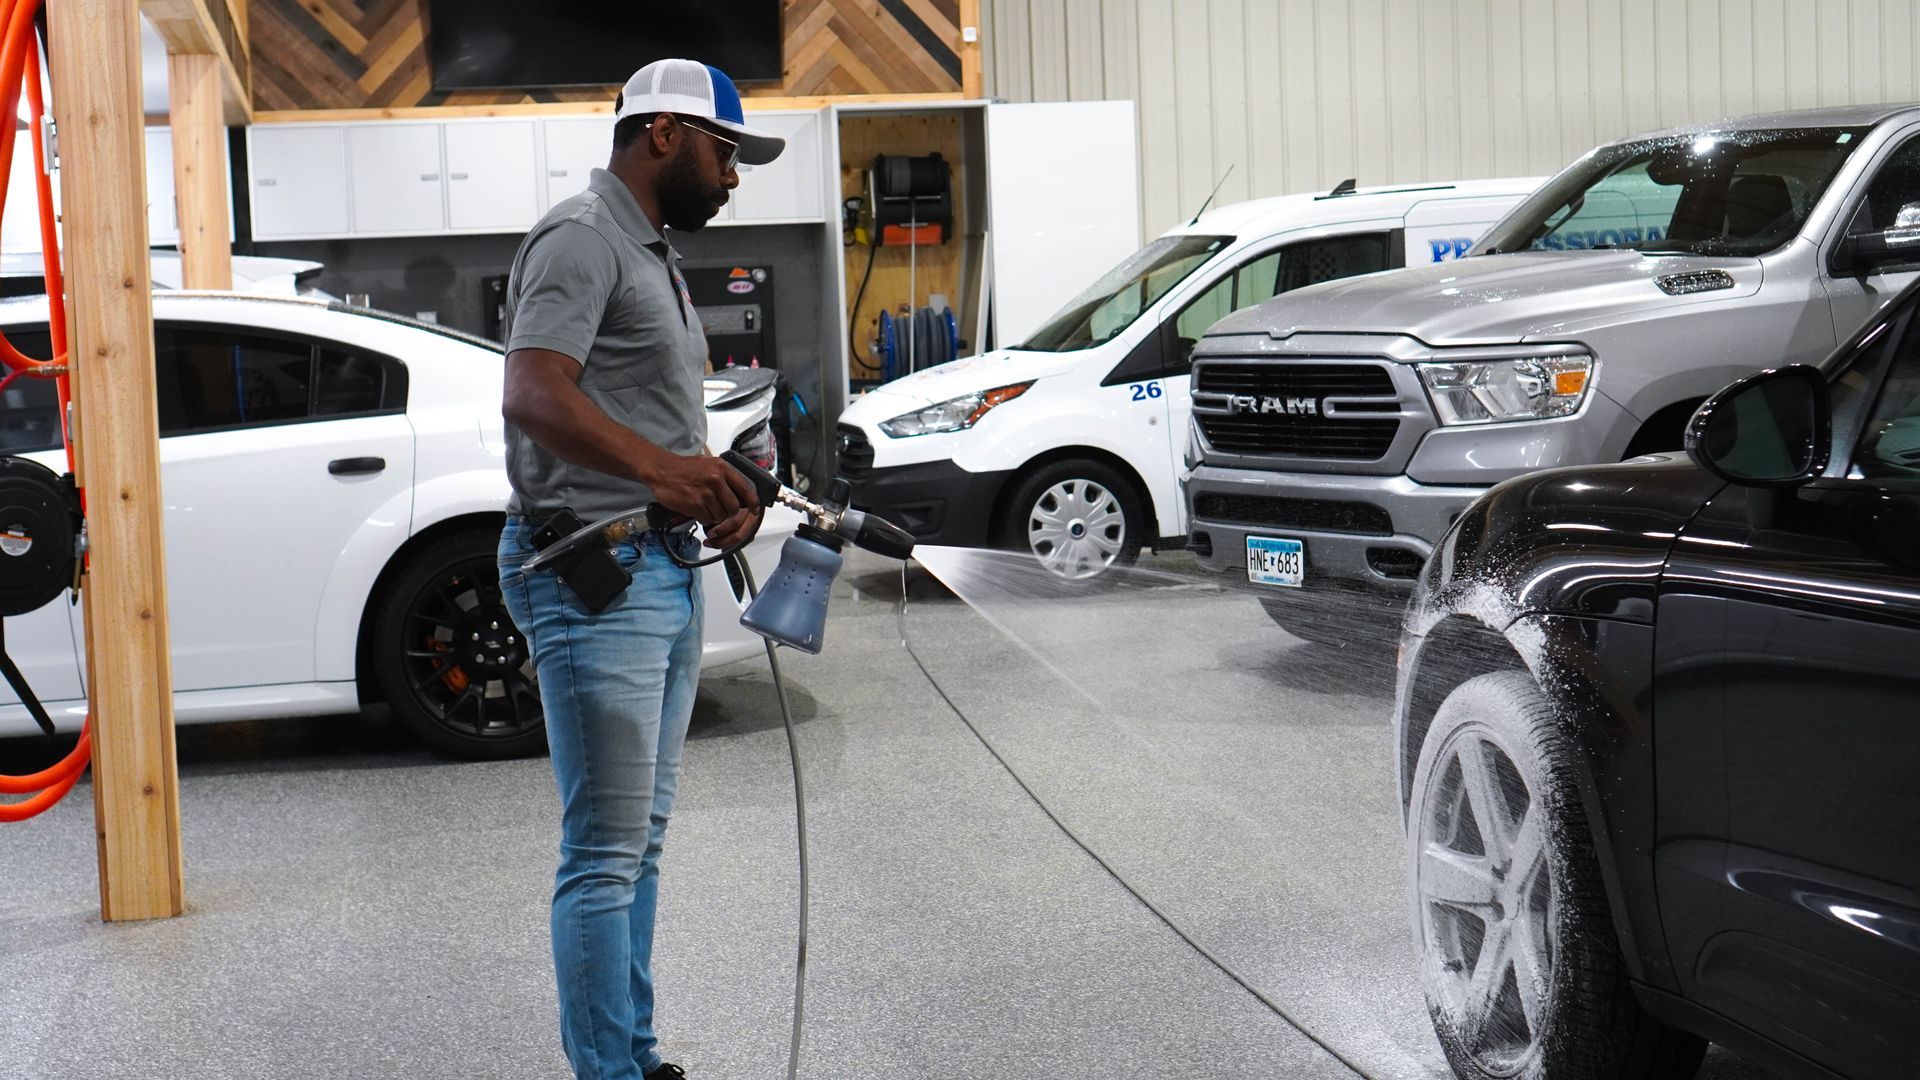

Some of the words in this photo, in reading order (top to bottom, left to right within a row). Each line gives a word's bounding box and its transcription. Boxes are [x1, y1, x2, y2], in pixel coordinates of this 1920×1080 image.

[1428, 226, 1670, 262] PRSSIONA
[1129, 381, 1162, 402] 26
[1233, 395, 1318, 415] RAM
